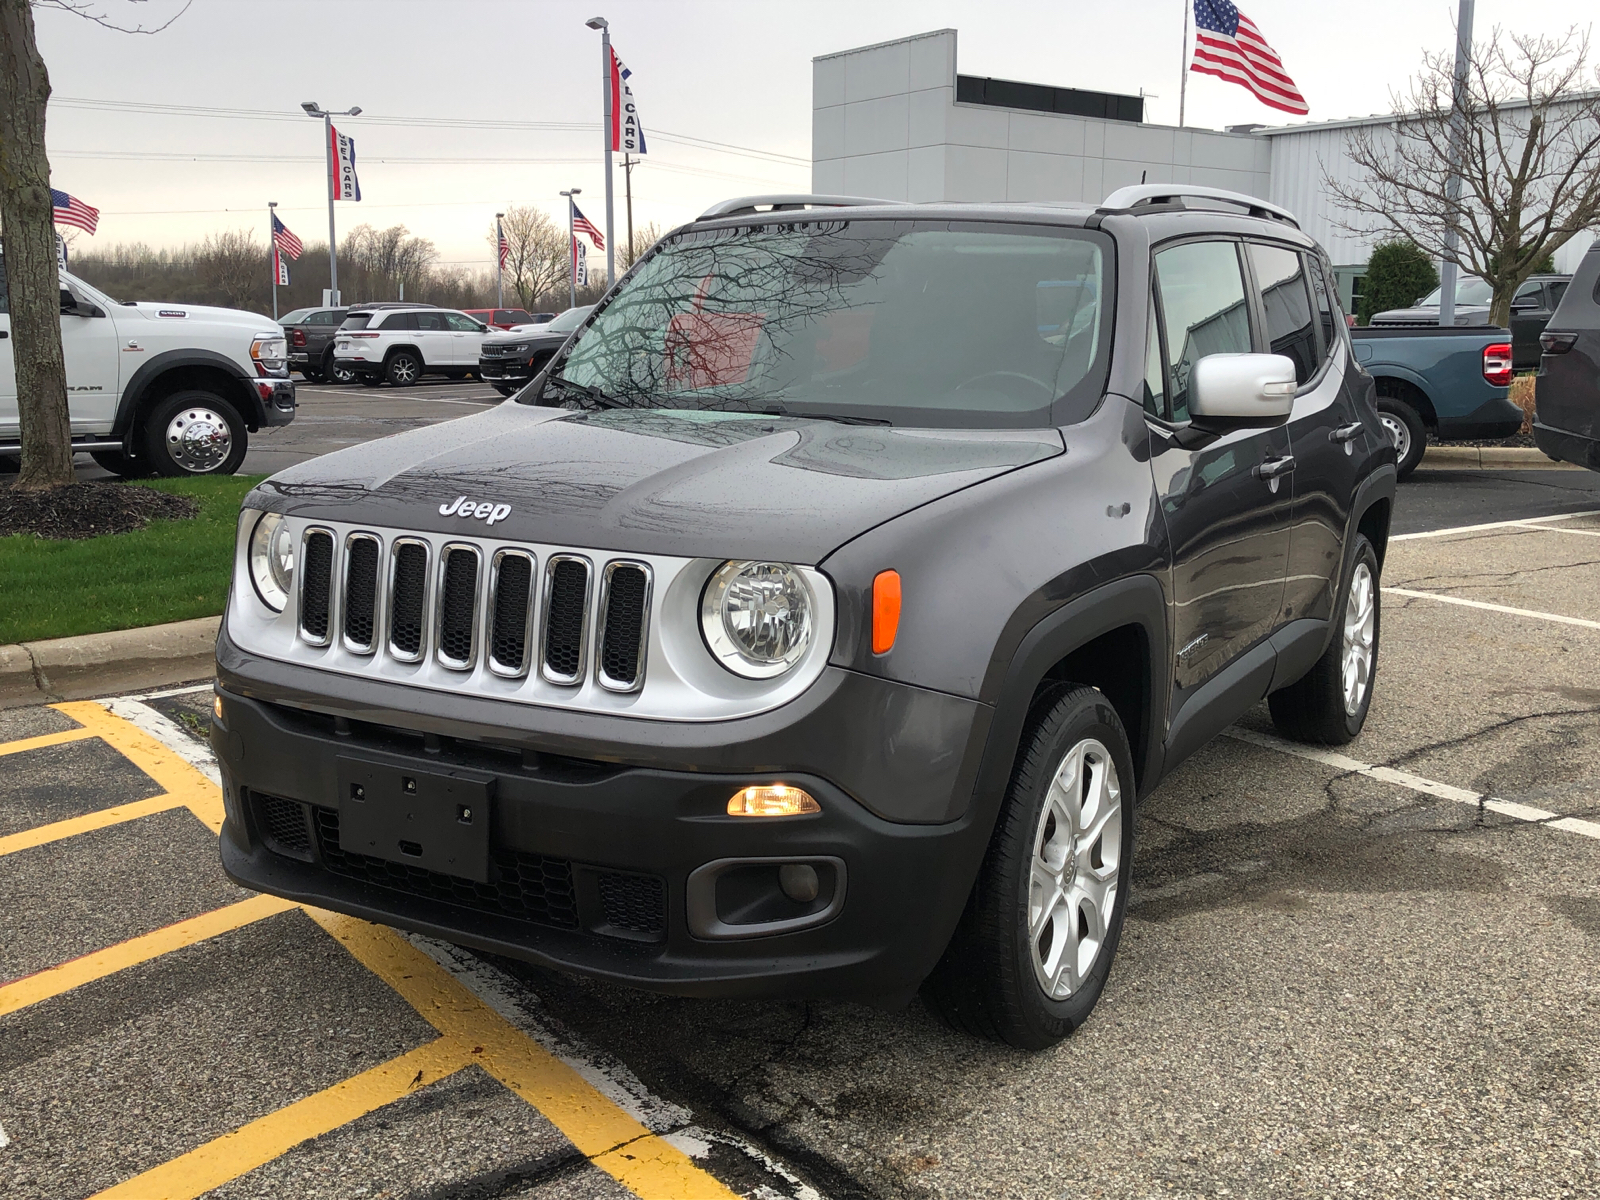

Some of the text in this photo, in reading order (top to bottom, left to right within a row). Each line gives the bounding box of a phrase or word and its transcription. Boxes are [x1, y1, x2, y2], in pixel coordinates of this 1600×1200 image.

[624, 103, 636, 149] CARS
[343, 166, 352, 198] CARS
[438, 495, 512, 526] Jeep
